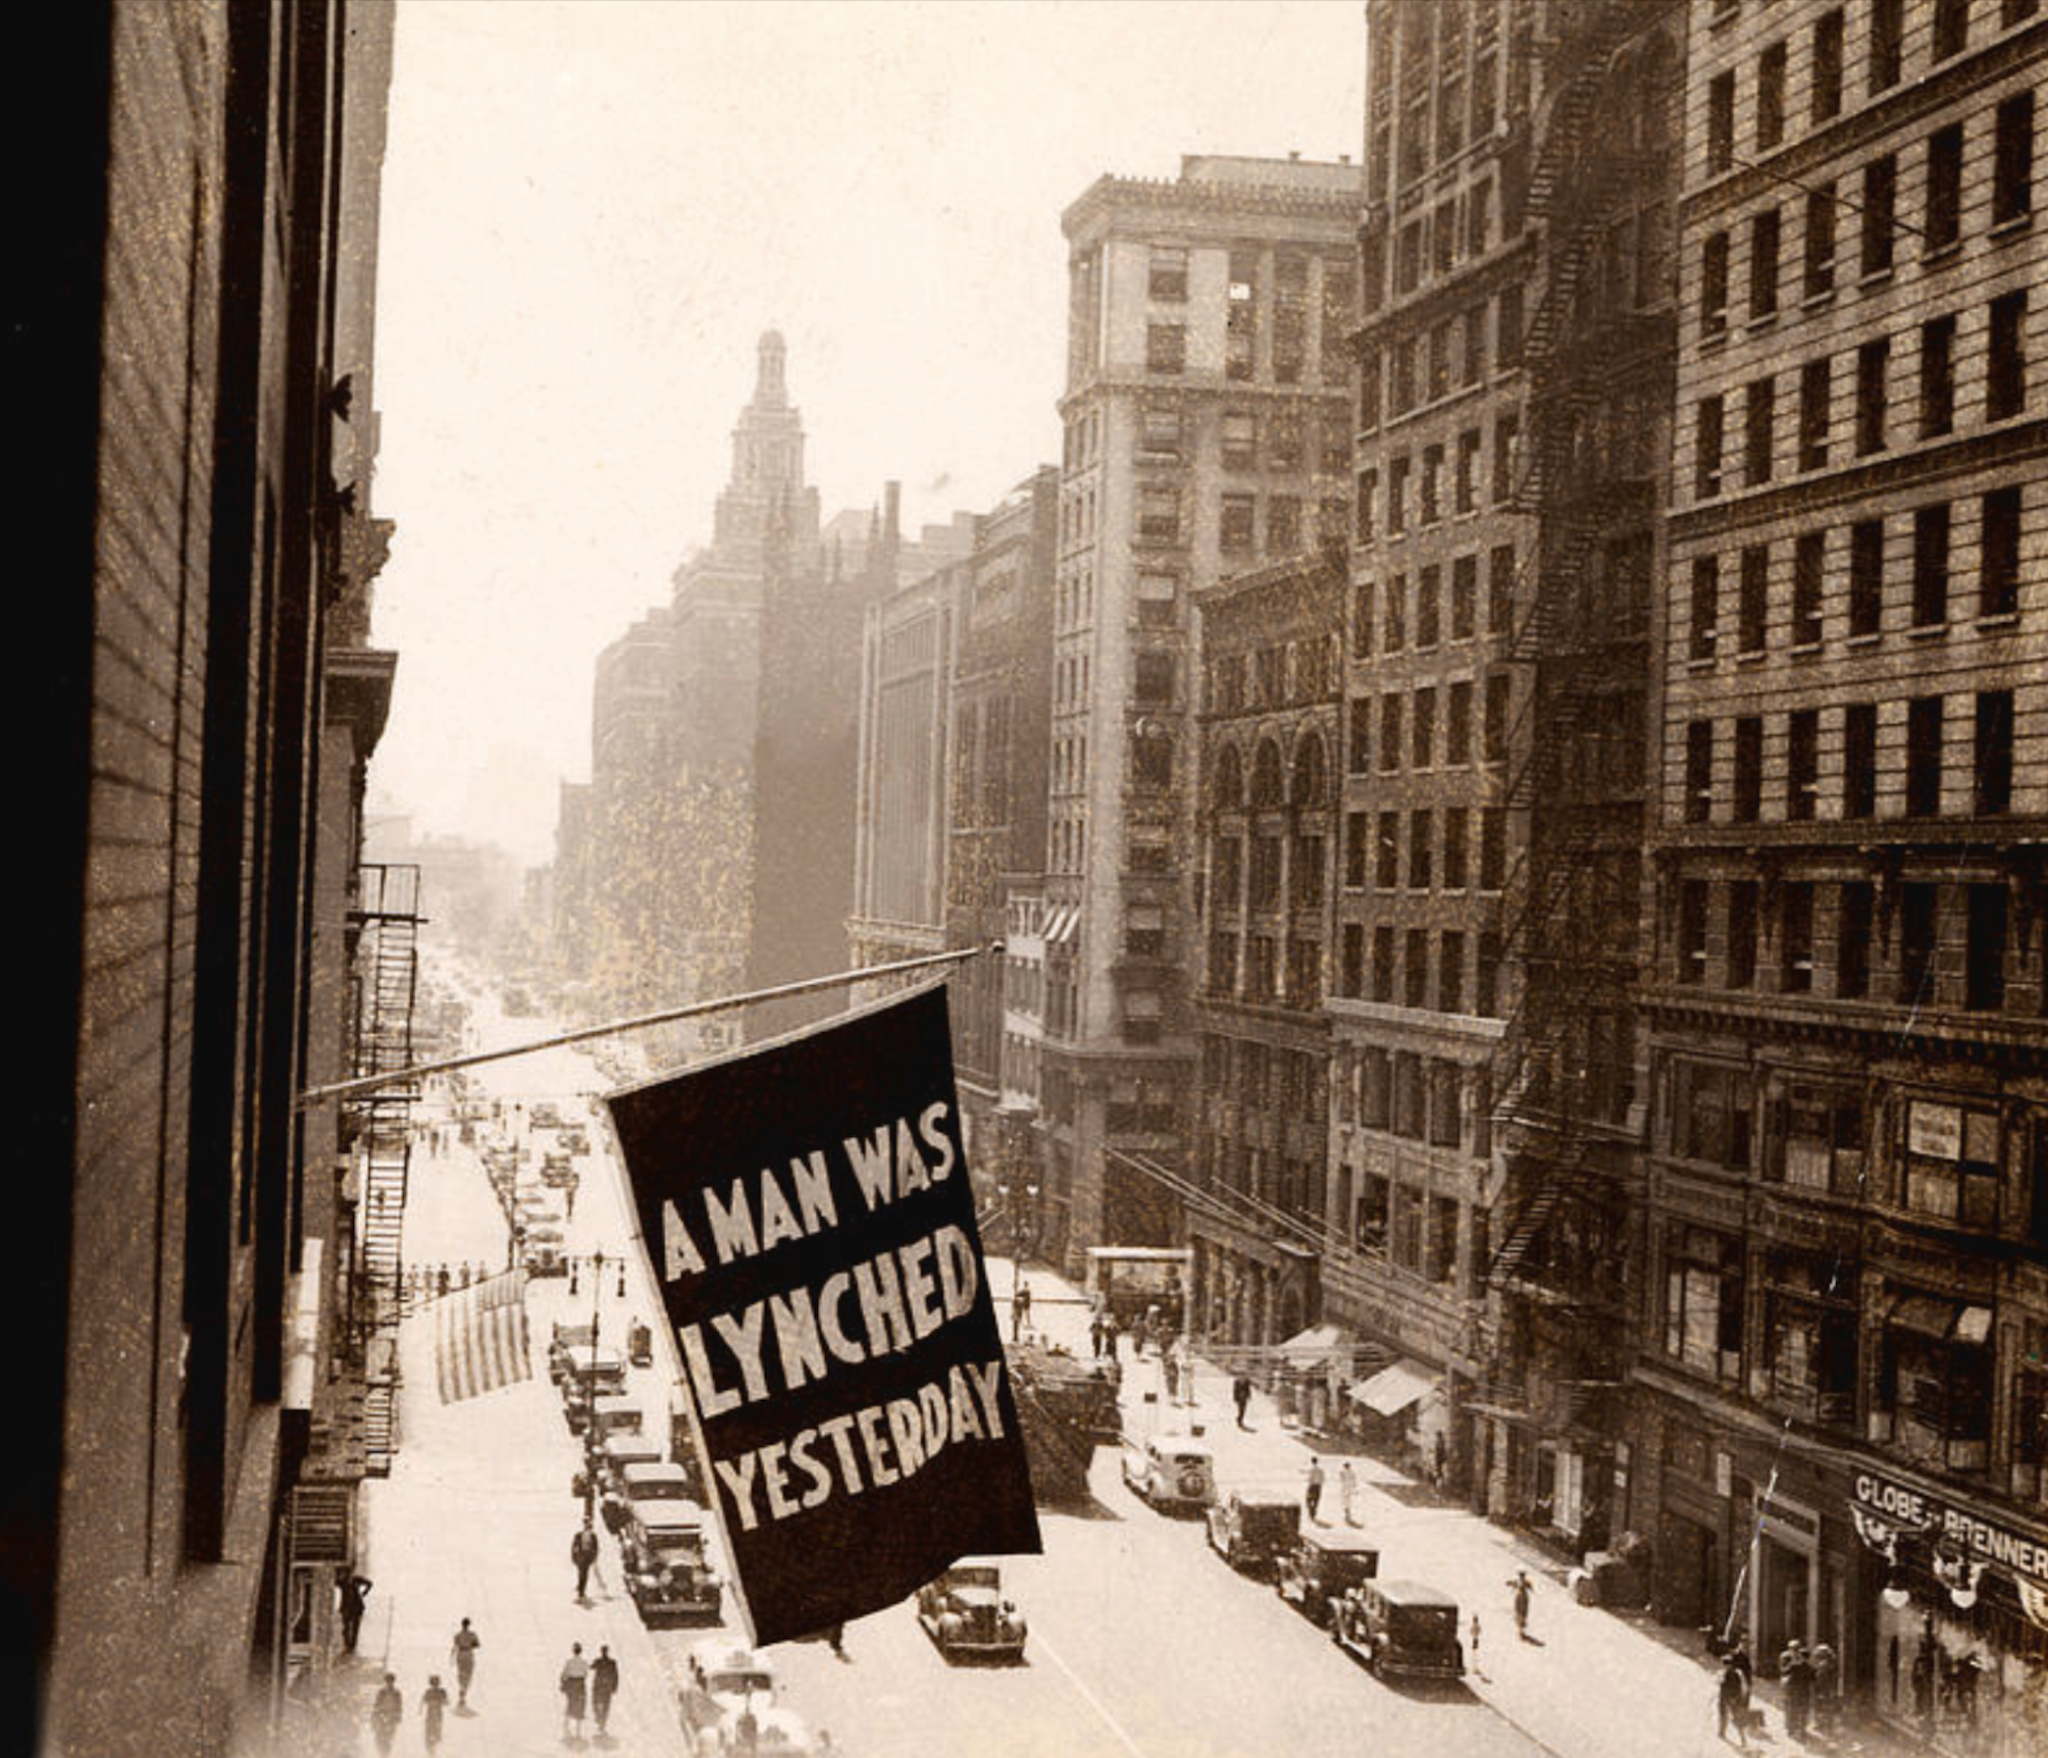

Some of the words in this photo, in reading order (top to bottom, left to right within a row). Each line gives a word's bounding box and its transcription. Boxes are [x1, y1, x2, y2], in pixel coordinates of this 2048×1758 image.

[662, 1199, 707, 1282] A
[703, 1150, 840, 1265] MAN
[842, 1101, 956, 1212] WAS
[679, 1224, 978, 1420] LYNCHED
[713, 1360, 1006, 1531] YESTERDAY
